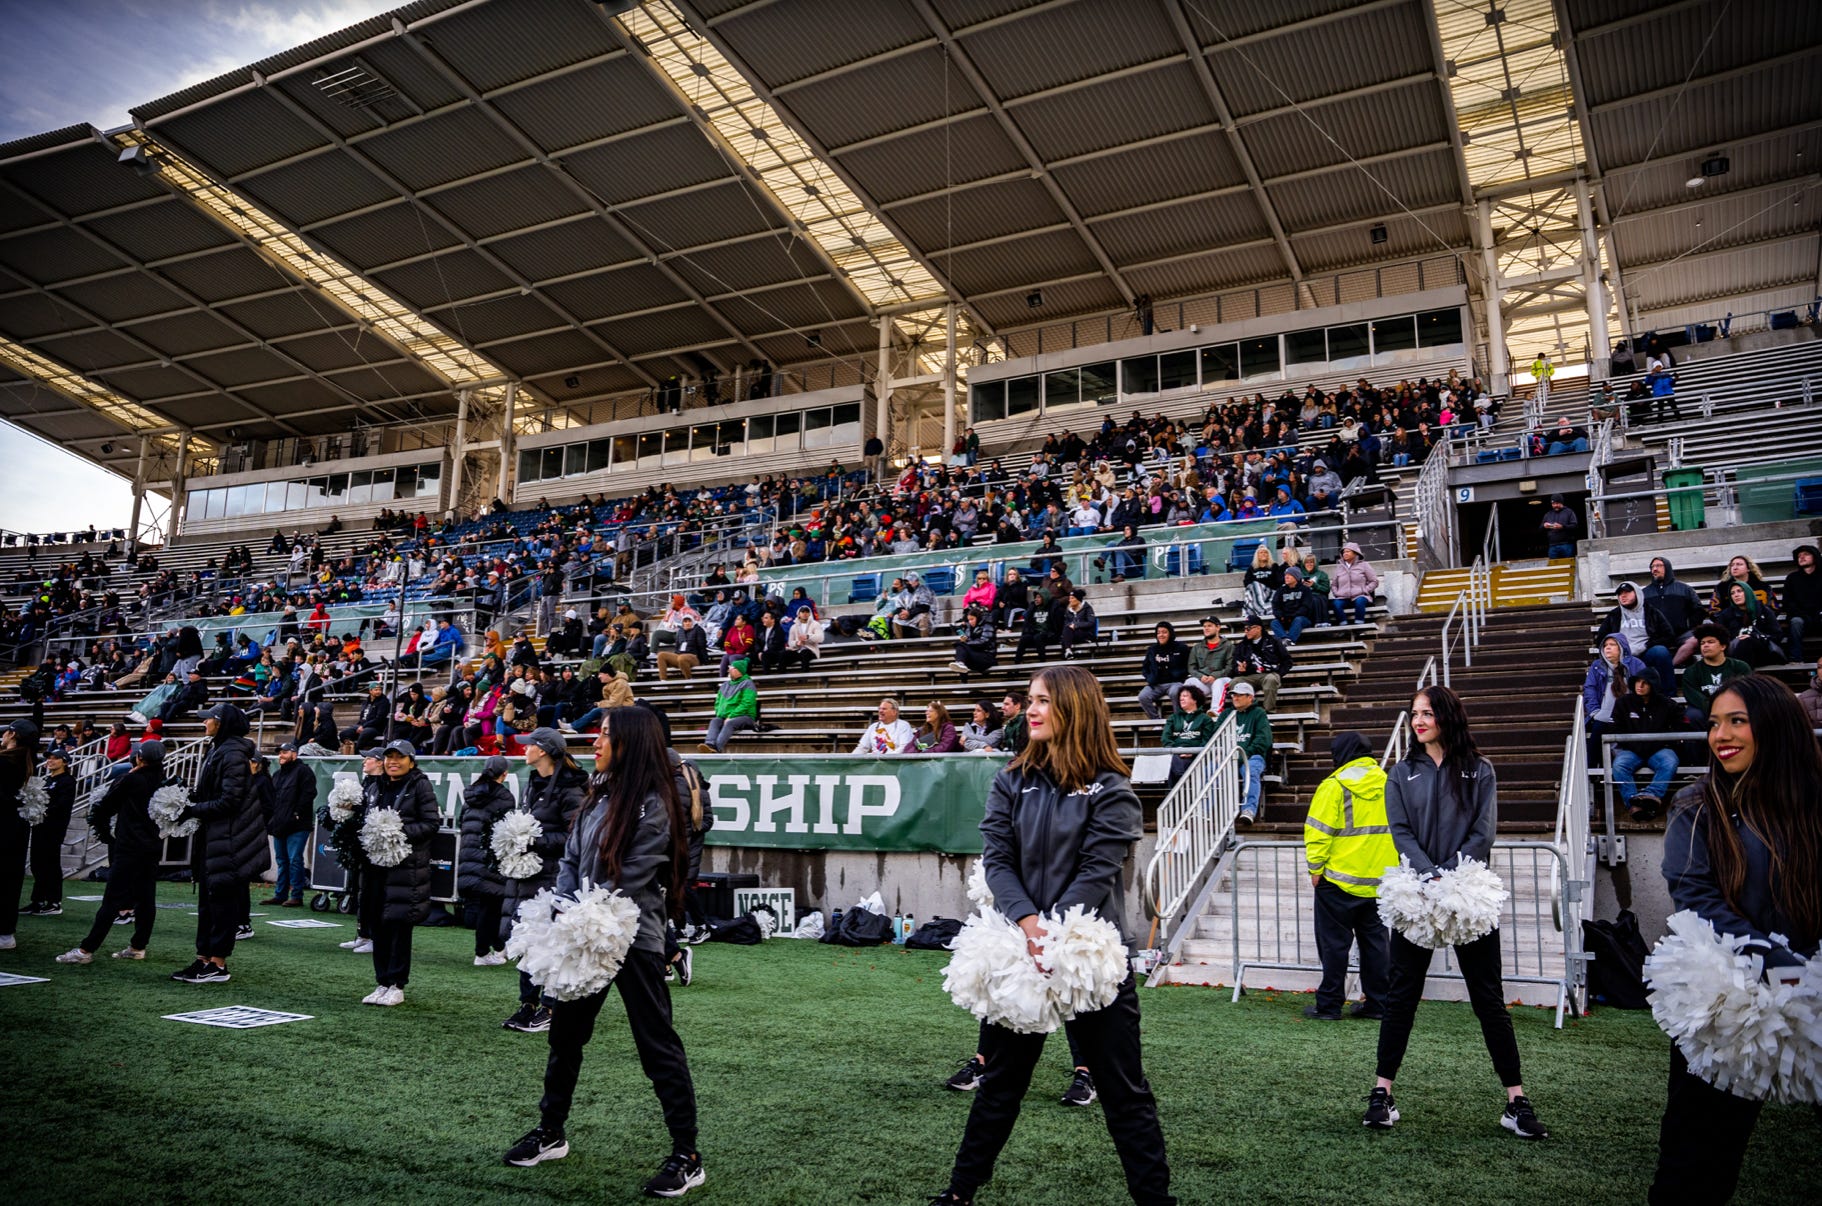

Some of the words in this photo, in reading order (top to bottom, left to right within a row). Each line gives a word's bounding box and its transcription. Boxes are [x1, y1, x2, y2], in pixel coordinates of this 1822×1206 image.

[1460, 488, 1470, 502] 9
[708, 774, 902, 835] SHIP
[738, 893, 792, 933] NSE
